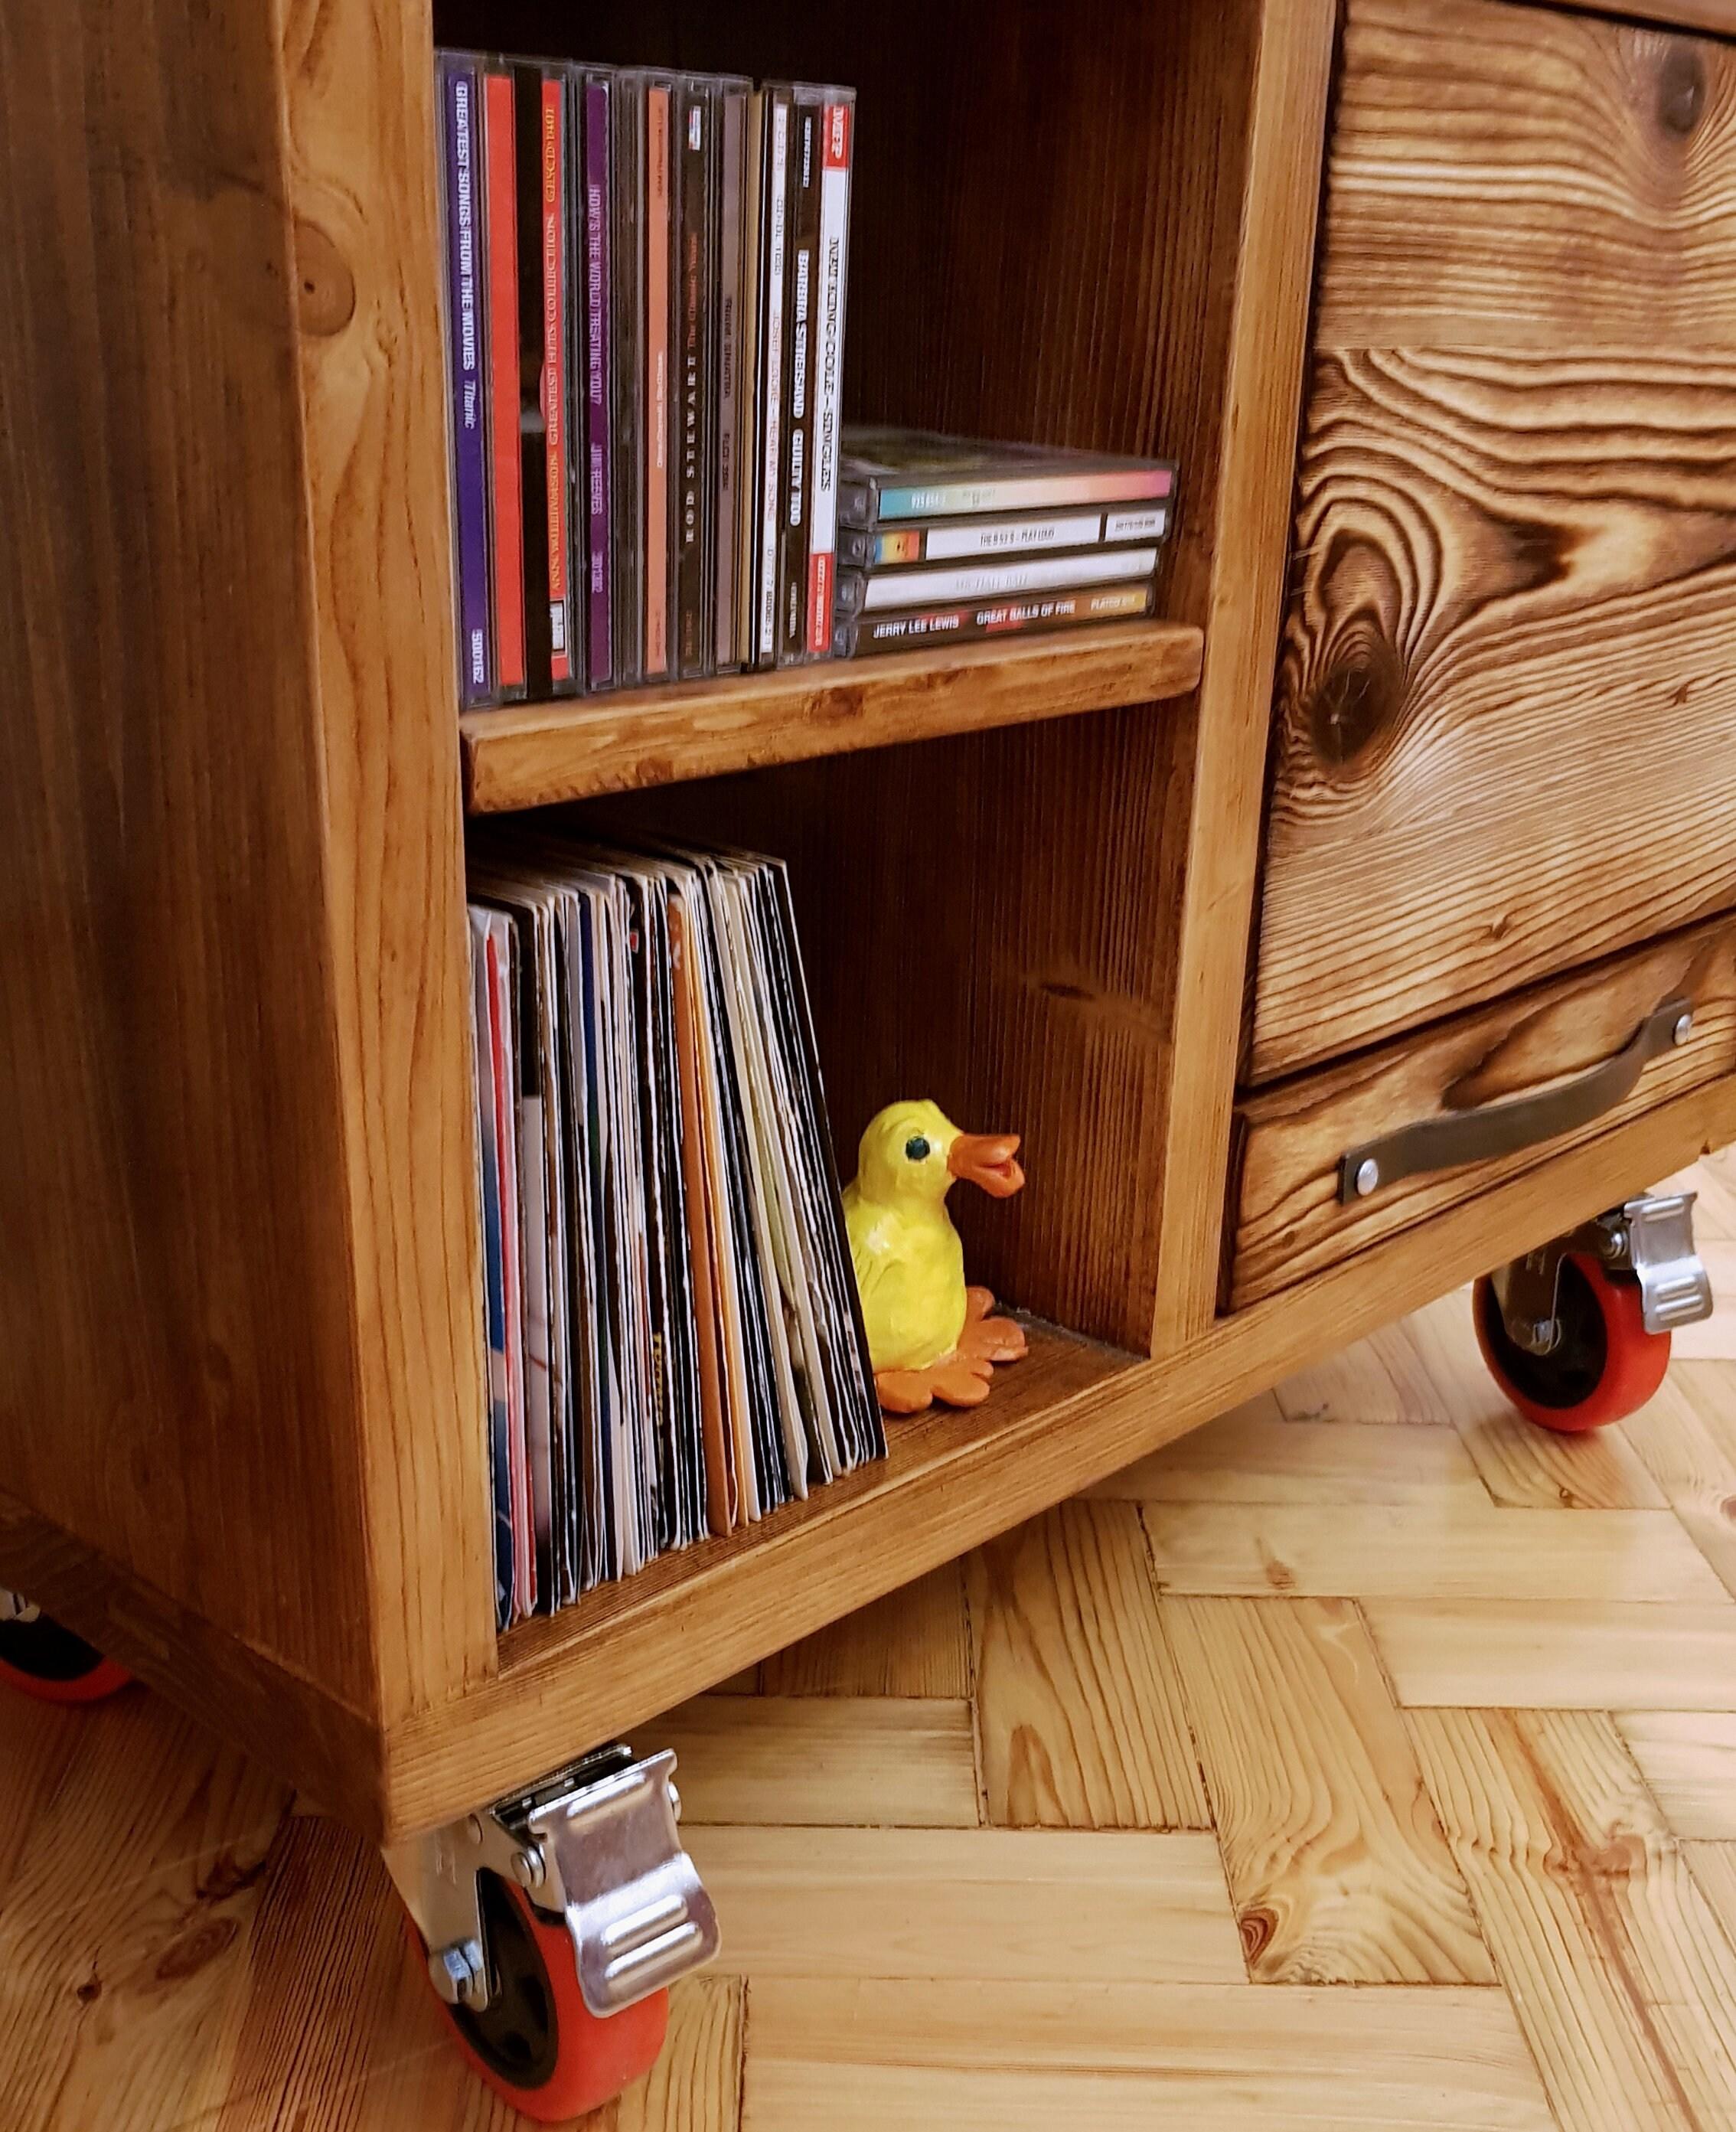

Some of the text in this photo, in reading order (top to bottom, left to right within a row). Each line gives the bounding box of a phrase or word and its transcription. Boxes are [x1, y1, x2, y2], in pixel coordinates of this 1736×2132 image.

[455, 81, 475, 371] GREATEST SONGS FROM THE MOVIES
[828, 237, 839, 279] NAT
[589, 184, 602, 406] HOW'S THE WORLD TREATING YOU?
[687, 275, 697, 322] Classic
[827, 282, 837, 335] KING
[546, 213, 557, 446] GREATEST HITS COLLECTION
[687, 325, 696, 351] The
[793, 250, 810, 418] BARBRA STREISAND
[723, 342, 732, 400] SINATRA
[824, 341, 836, 393] COLE
[464, 380, 476, 429] Titanic
[686, 354, 697, 544] ROD STEWART
[821, 410, 833, 492] SINGLES
[591, 442, 603, 515] JIM REEVES
[767, 482, 776, 521] SONG
[790, 429, 804, 526] GUILTY TOO
[873, 614, 960, 638] JERRY LEE LEWIS
[977, 599, 1076, 626] GREAT BALLS OF FIRE
